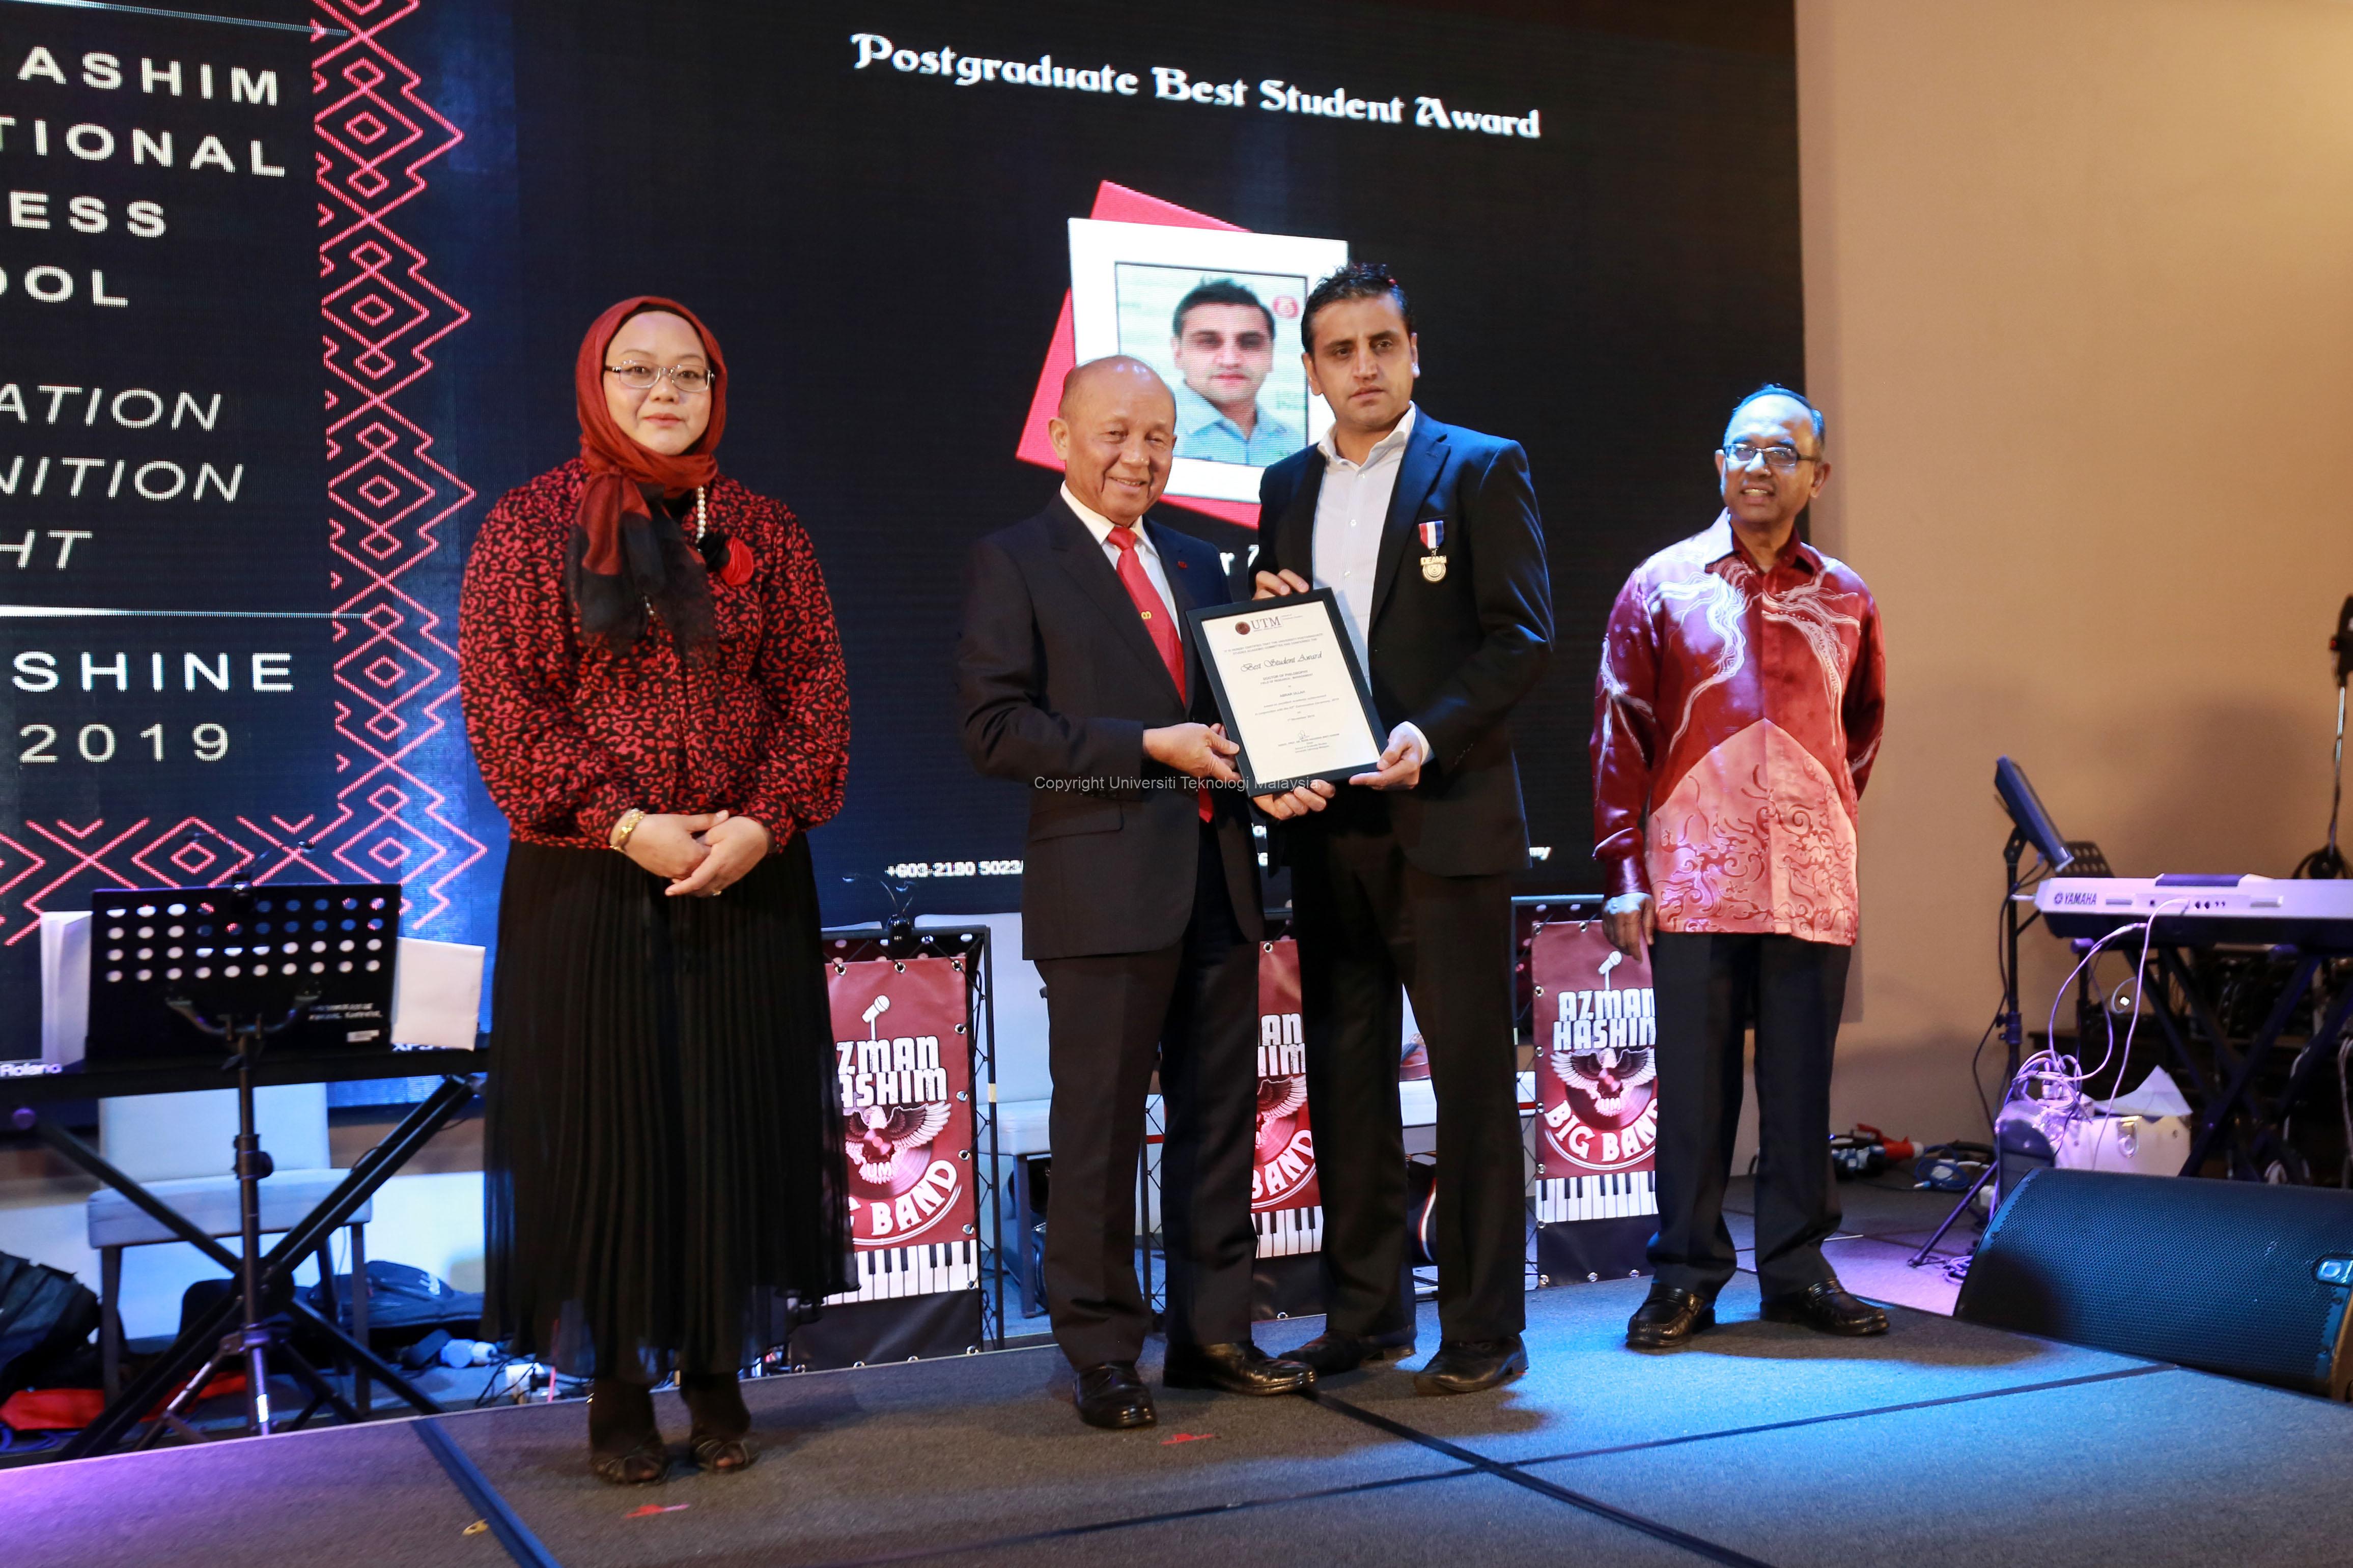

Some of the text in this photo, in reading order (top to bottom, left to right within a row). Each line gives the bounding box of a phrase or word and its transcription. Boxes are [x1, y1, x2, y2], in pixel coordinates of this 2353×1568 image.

[18, 46, 278, 106] ASHIM
[850, 33, 1540, 138] Postgraduate Best Student Award
[9, 190, 166, 238] ESS
[0, 265, 129, 307] OL
[0, 383, 222, 432] ATION
[1250, 616, 1281, 629] UTM
[12, 650, 294, 693] SHINE
[1241, 651, 1322, 672] Best Student Award
[18, 723, 230, 763] 2019
[2065, 892, 2096, 905] YAMAHA
[1558, 988, 1655, 1021] AZMAN
[1544, 1100, 1595, 1159] BIG
[870, 1160, 958, 1236] BAND
